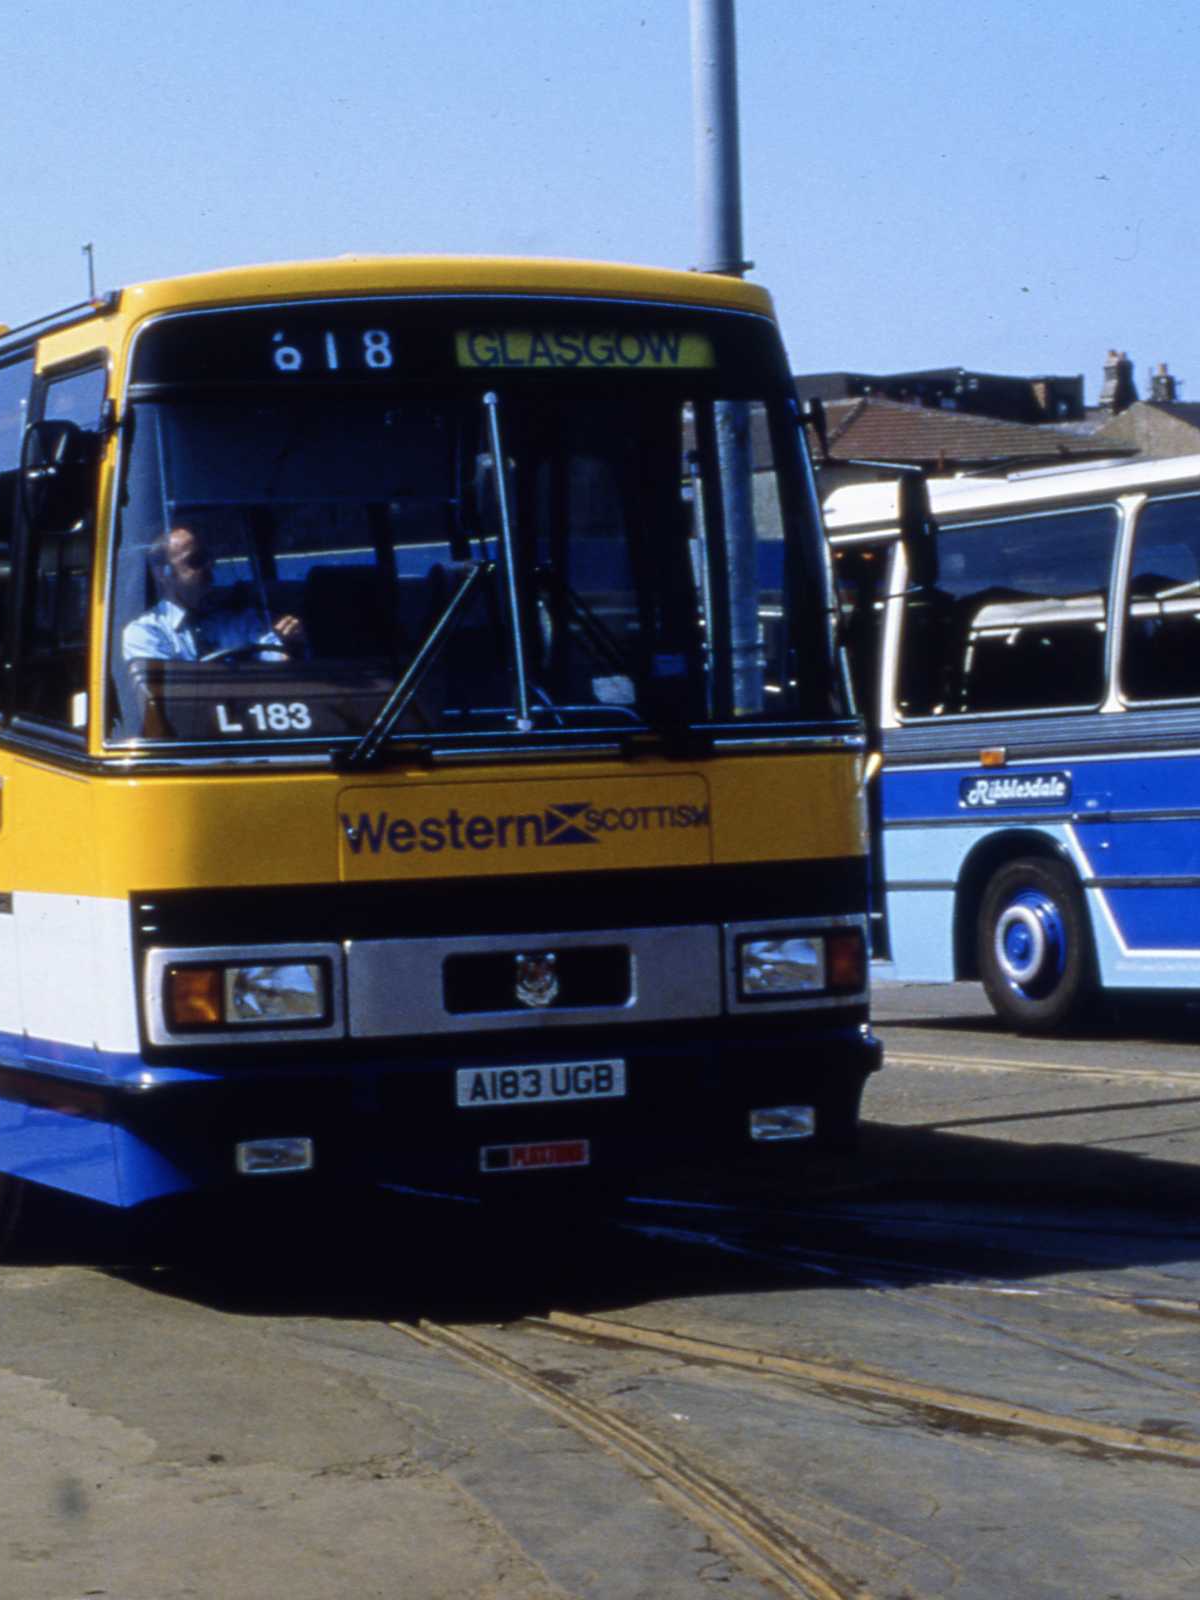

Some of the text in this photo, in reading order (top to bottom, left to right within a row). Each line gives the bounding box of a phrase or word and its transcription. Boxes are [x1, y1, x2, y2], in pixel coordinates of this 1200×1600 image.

[467, 328, 680, 366] GLASGOW
[216, 702, 312, 732] L 183
[967, 777, 1066, 805] Ribblesdale
[341, 803, 710, 855] Western SCOTTISH
[469, 1064, 613, 1102] A183 UGB
